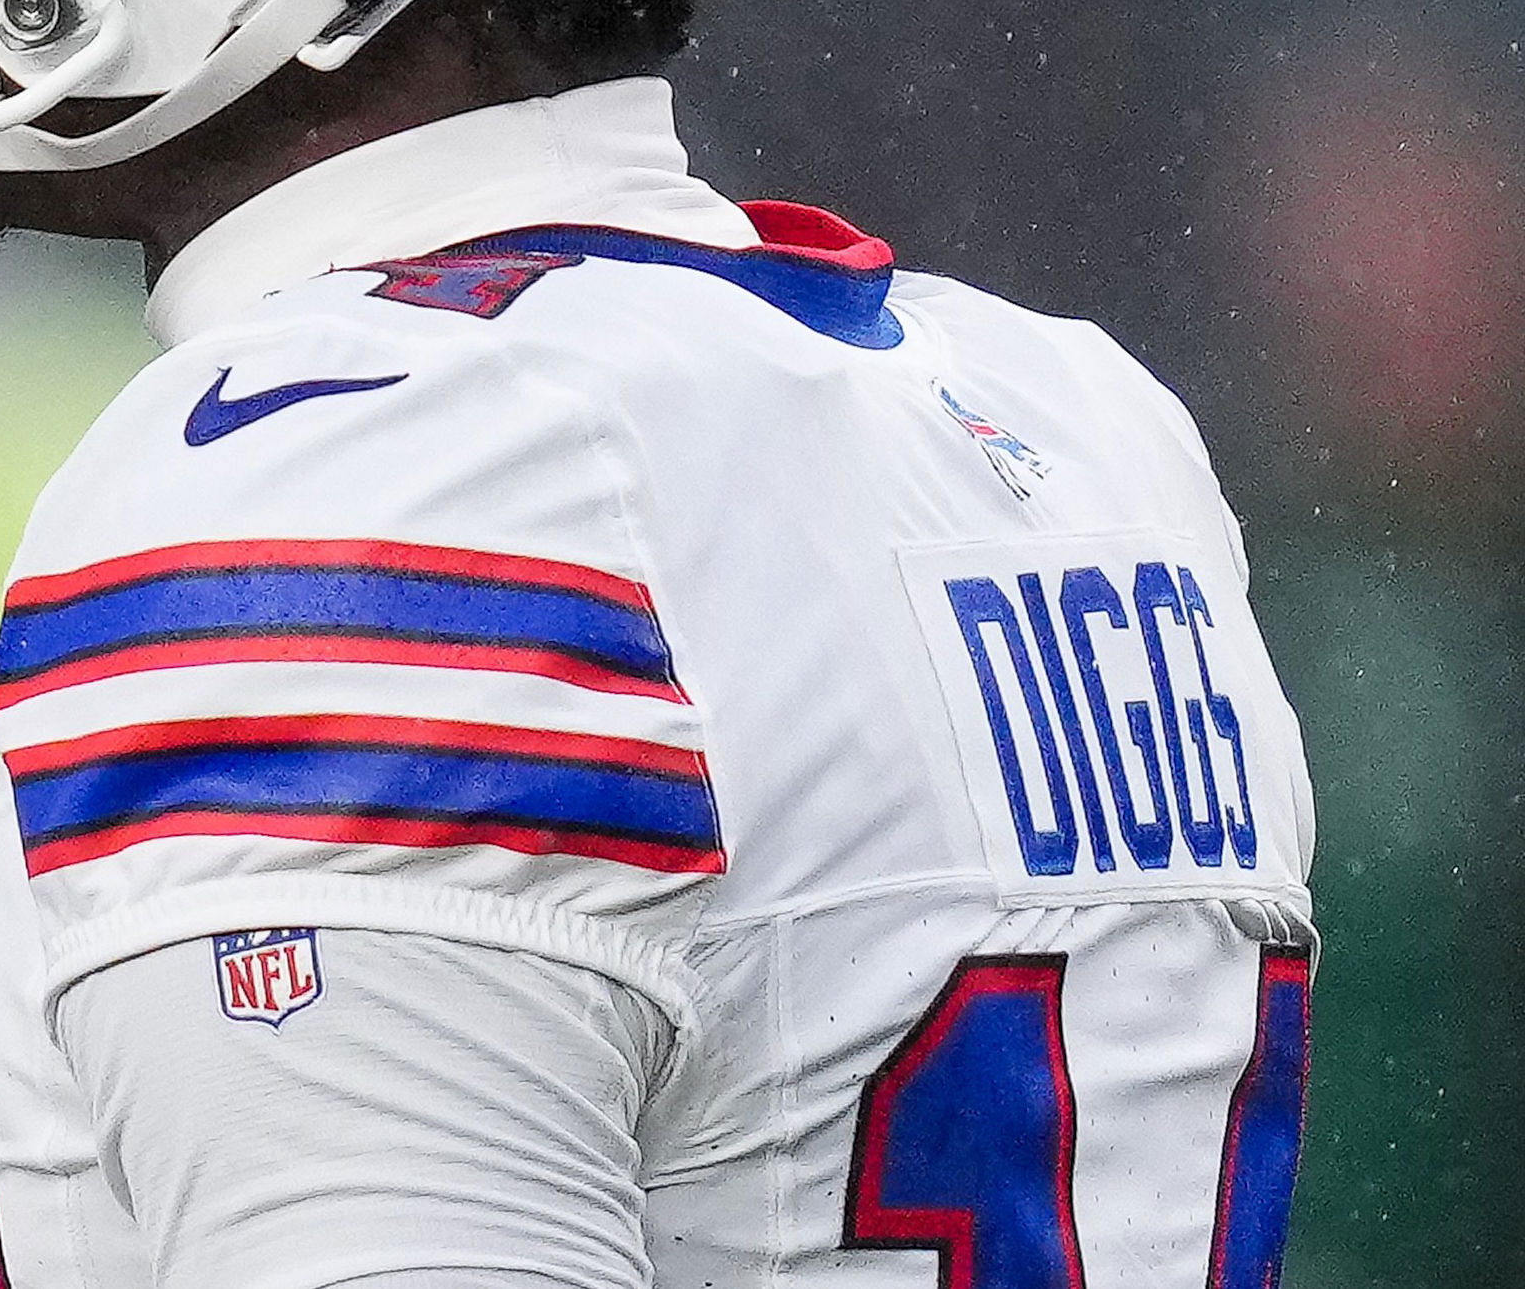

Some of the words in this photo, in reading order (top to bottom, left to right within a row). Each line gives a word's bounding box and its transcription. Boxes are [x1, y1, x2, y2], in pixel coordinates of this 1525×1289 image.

[943, 561, 1257, 877] DIGGS
[224, 944, 314, 1011] NFL
[838, 943, 1312, 1289] 1
